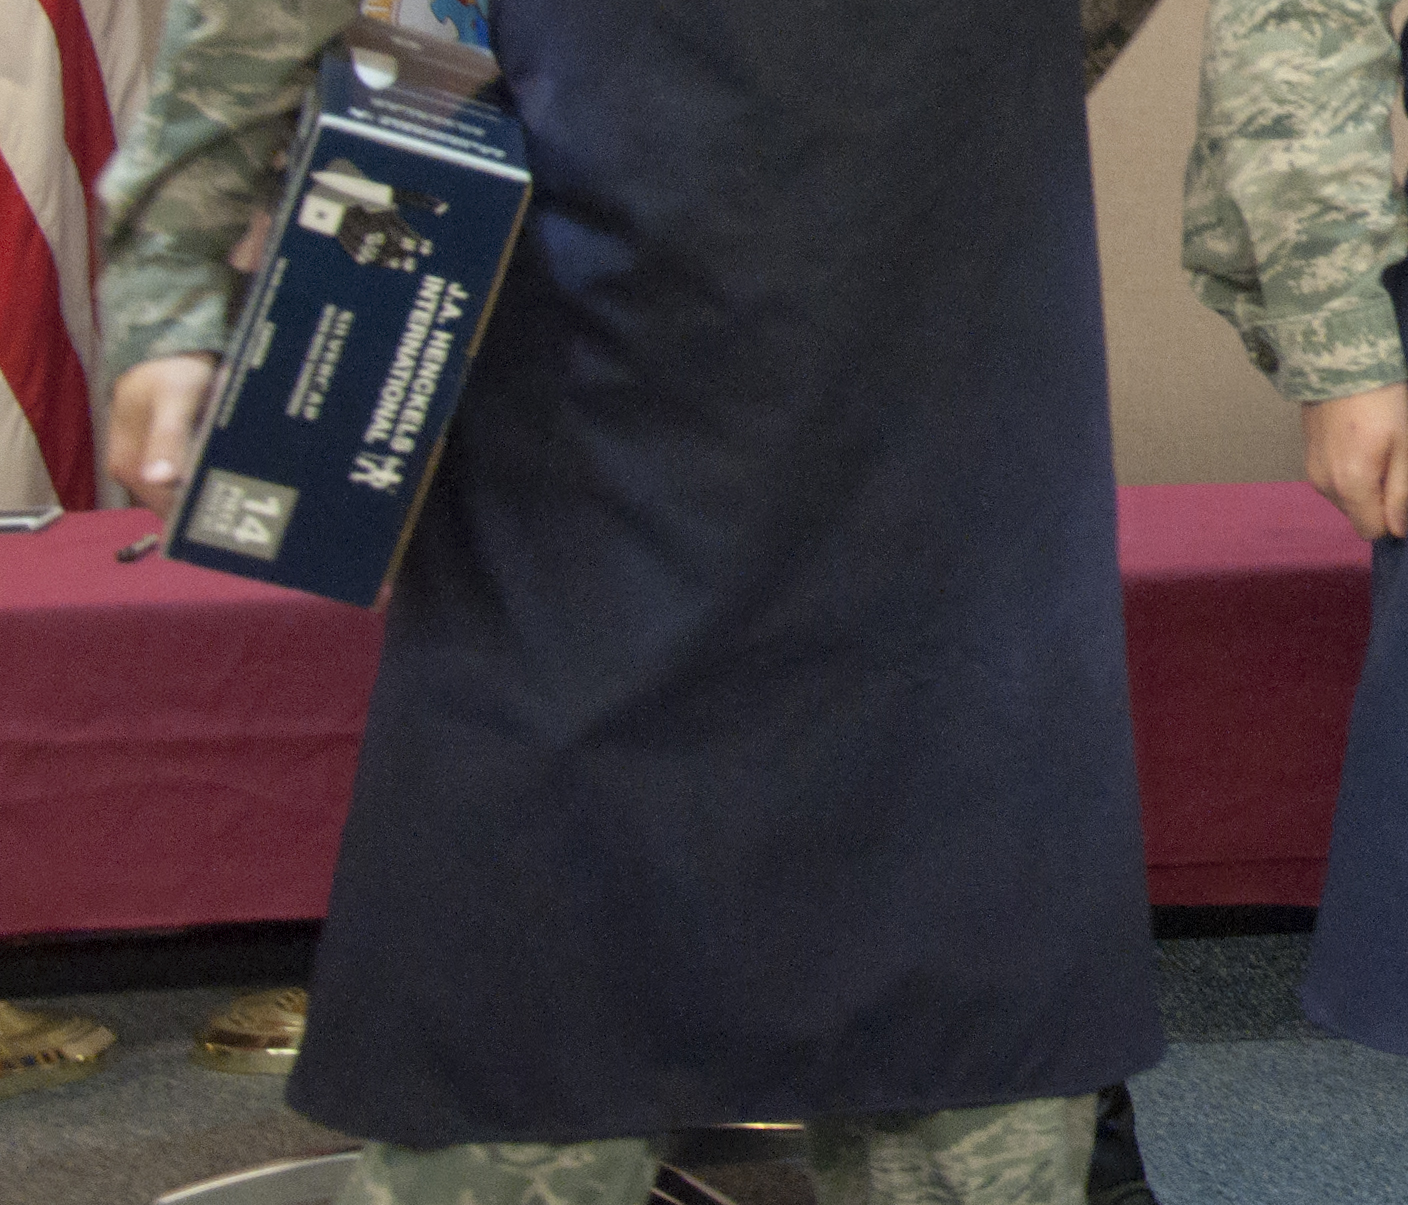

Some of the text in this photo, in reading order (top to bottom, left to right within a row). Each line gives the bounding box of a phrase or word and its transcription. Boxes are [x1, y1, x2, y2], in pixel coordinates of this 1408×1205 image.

[363, 274, 447, 445] INTERNATIONAL
[389, 282, 469, 453] J.A. HENCKELS
[233, 496, 281, 544] 14
